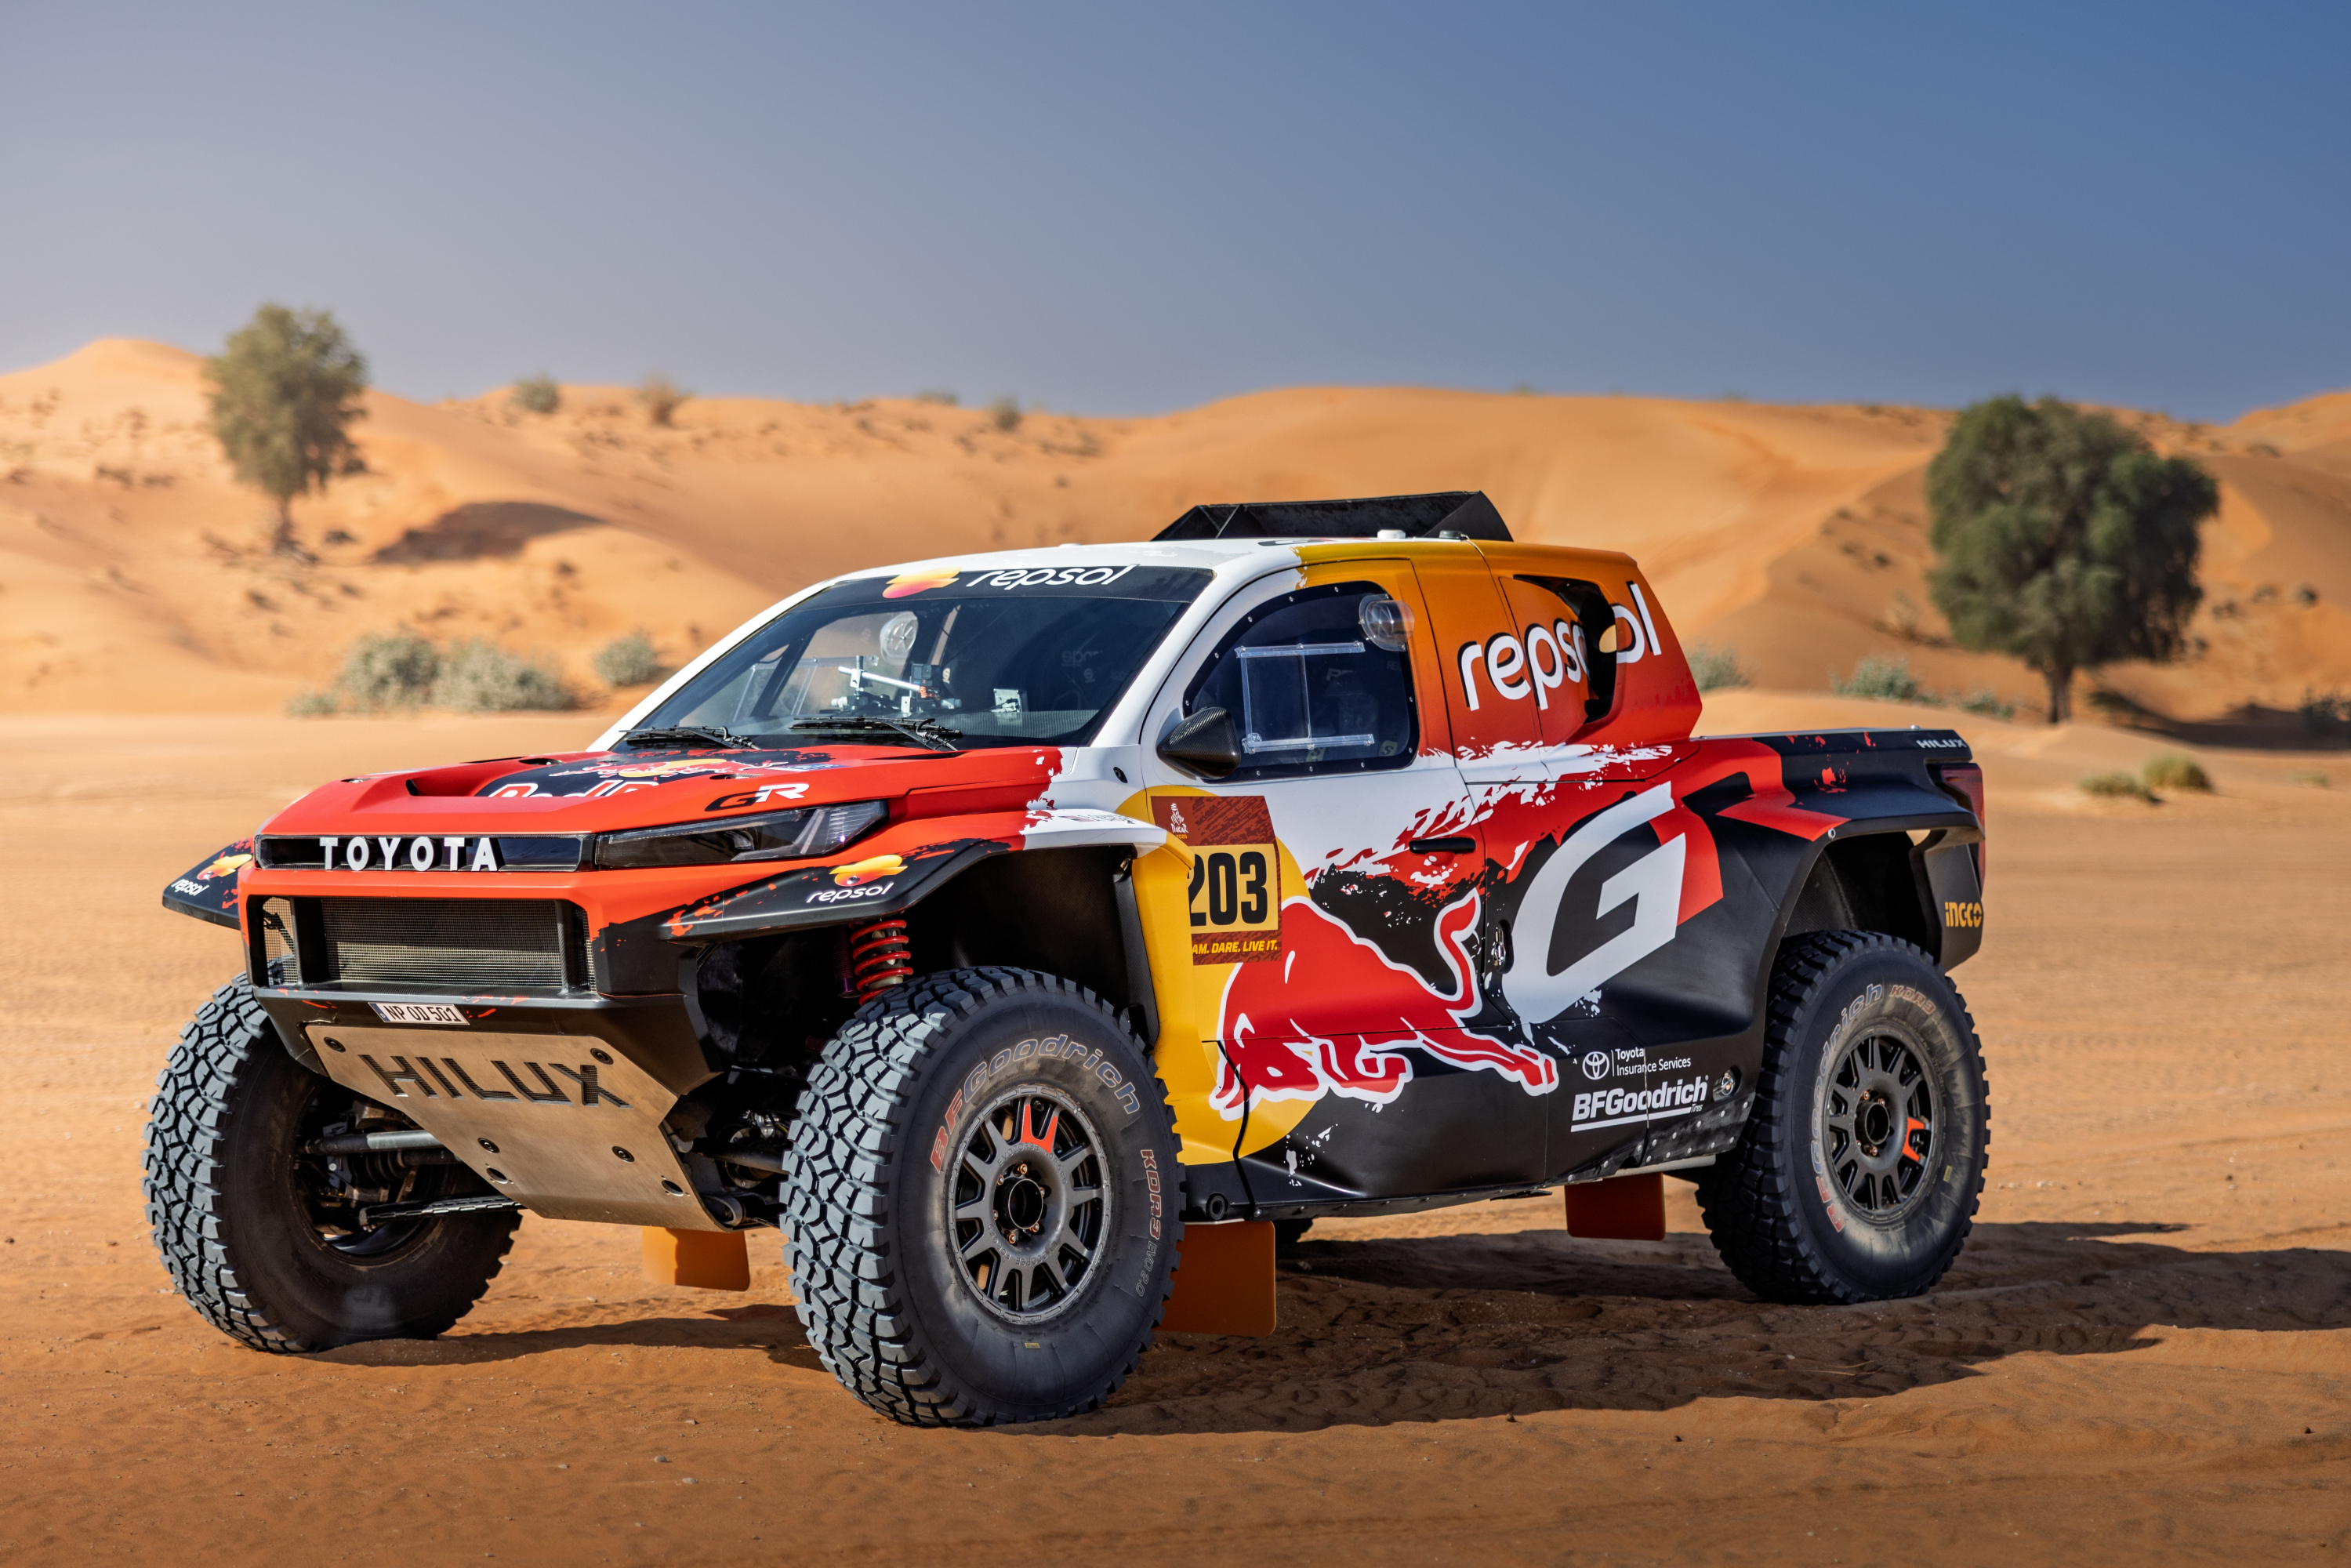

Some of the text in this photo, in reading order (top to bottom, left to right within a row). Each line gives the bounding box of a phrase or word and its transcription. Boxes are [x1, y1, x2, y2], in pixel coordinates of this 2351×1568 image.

[966, 564, 1140, 590] repsol
[1458, 580, 1662, 712] repsol
[1915, 739, 1967, 749] HILUX
[704, 783, 810, 811] GR
[1170, 823, 1189, 833] DAKAR
[319, 837, 499, 871] TOYOTA
[171, 879, 210, 896] repsol
[806, 883, 894, 903] repsol
[1187, 851, 1268, 927] 203
[1211, 942, 1241, 954] DARE.
[1243, 940, 1265, 953] LIVE
[1266, 940, 1278, 951] IT.
[383, 1006, 406, 1020] NP
[1888, 985, 1936, 1014] KDR3
[1615, 1047, 1644, 1061] Toyota
[1616, 1057, 1691, 1076] Insurance Services
[357, 1054, 633, 1109] HILUX
[930, 1034, 1141, 1174] BFGoodrich
[1572, 1076, 1707, 1121] BFGoodrich
[1690, 1103, 1703, 1112] Tires
[1811, 983, 1882, 1232] BFGoodrich
[1140, 1149, 1161, 1240] KDR3
